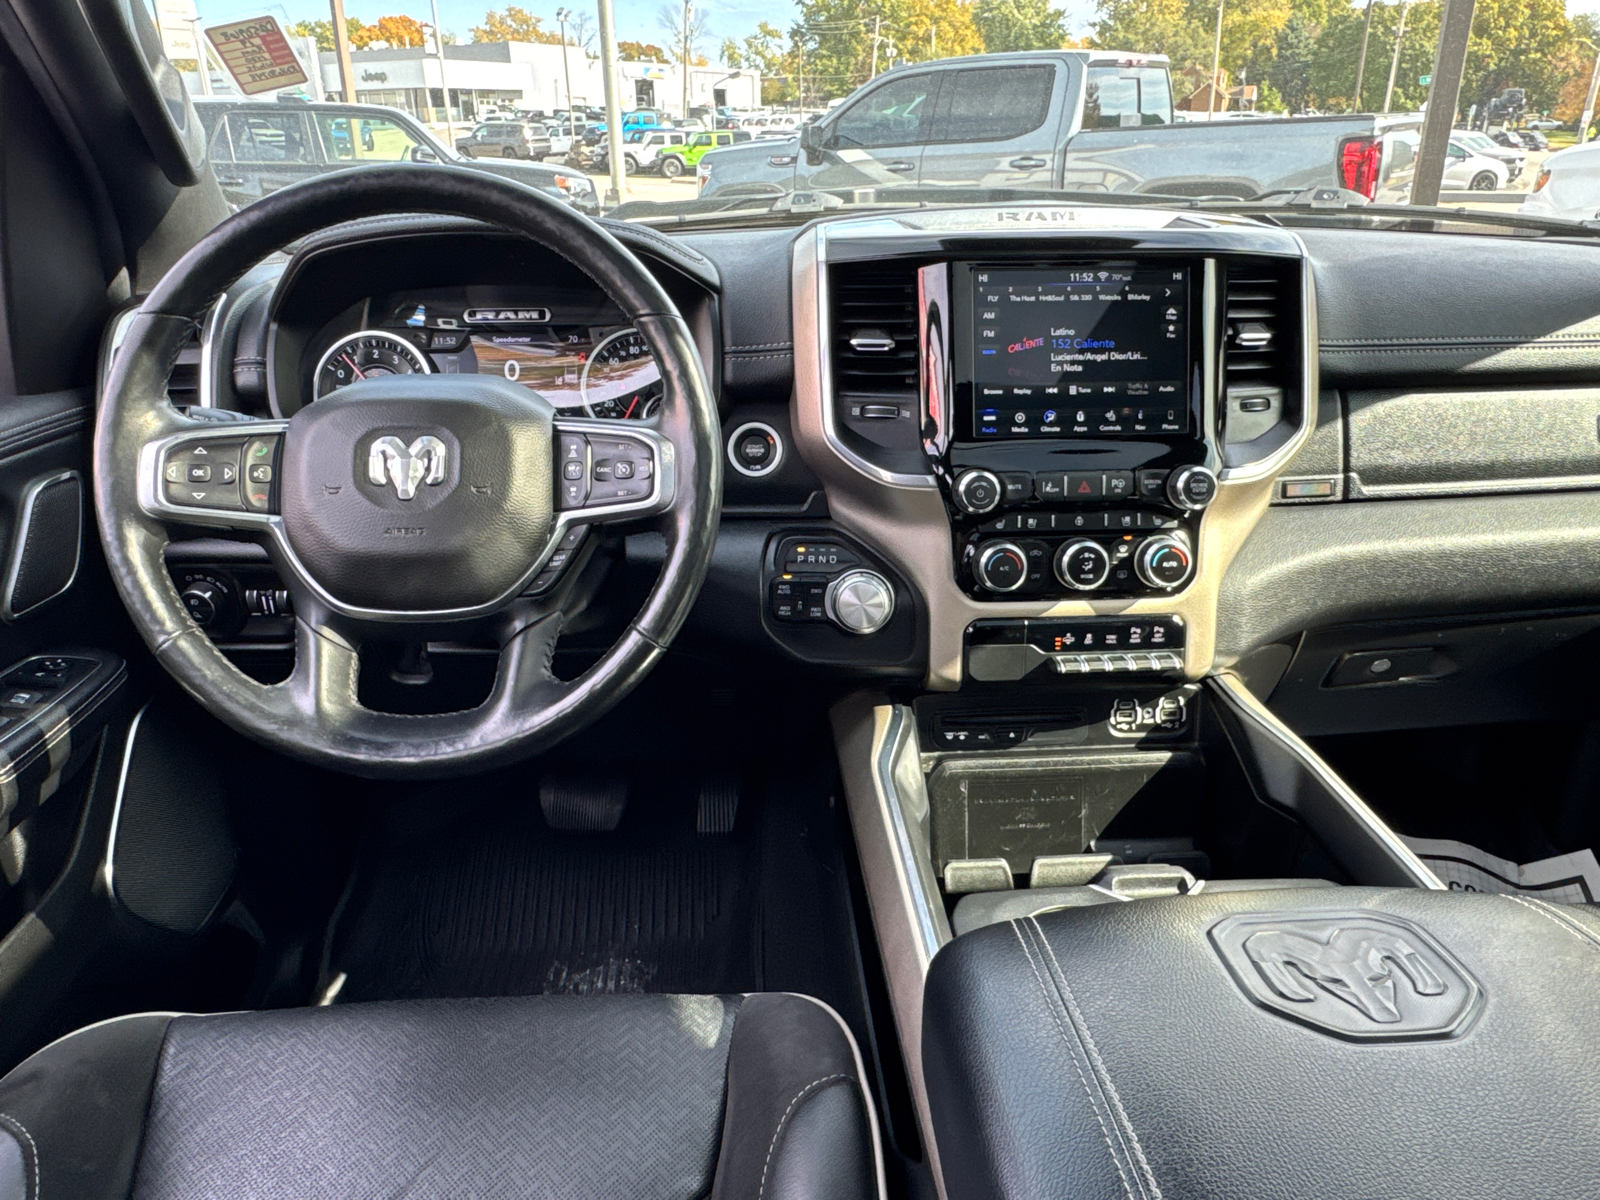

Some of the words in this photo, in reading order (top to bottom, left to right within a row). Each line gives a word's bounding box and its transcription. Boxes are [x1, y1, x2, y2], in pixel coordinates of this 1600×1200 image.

[361, 69, 388, 84] Jeep
[997, 211, 1075, 222] RAM
[978, 274, 988, 282] HI
[1069, 272, 1094, 282] 11:52
[1172, 272, 1182, 280] HI
[474, 310, 540, 320] RAM
[982, 312, 996, 320] AM
[983, 330, 996, 338] FM
[1050, 327, 1076, 336] Latino
[434, 336, 457, 345] 11:52
[568, 335, 579, 343] 70
[1051, 338, 1071, 349] 152
[1073, 337, 1116, 349] Caliente
[372, 349, 379, 359] 2
[629, 345, 640, 355] 80
[392, 355, 399, 364] 3
[504, 359, 520, 382] 0
[1050, 363, 1062, 373] En
[1063, 363, 1084, 373] Nota
[337, 369, 345, 378] 0
[981, 426, 998, 434] Radio
[1161, 423, 1179, 431] Phone
[192, 468, 205, 477] OK
[385, 527, 425, 536] AIRBAG
[797, 555, 805, 563] P
[808, 555, 815, 563] R
[819, 555, 826, 563] N
[829, 555, 837, 564] D
